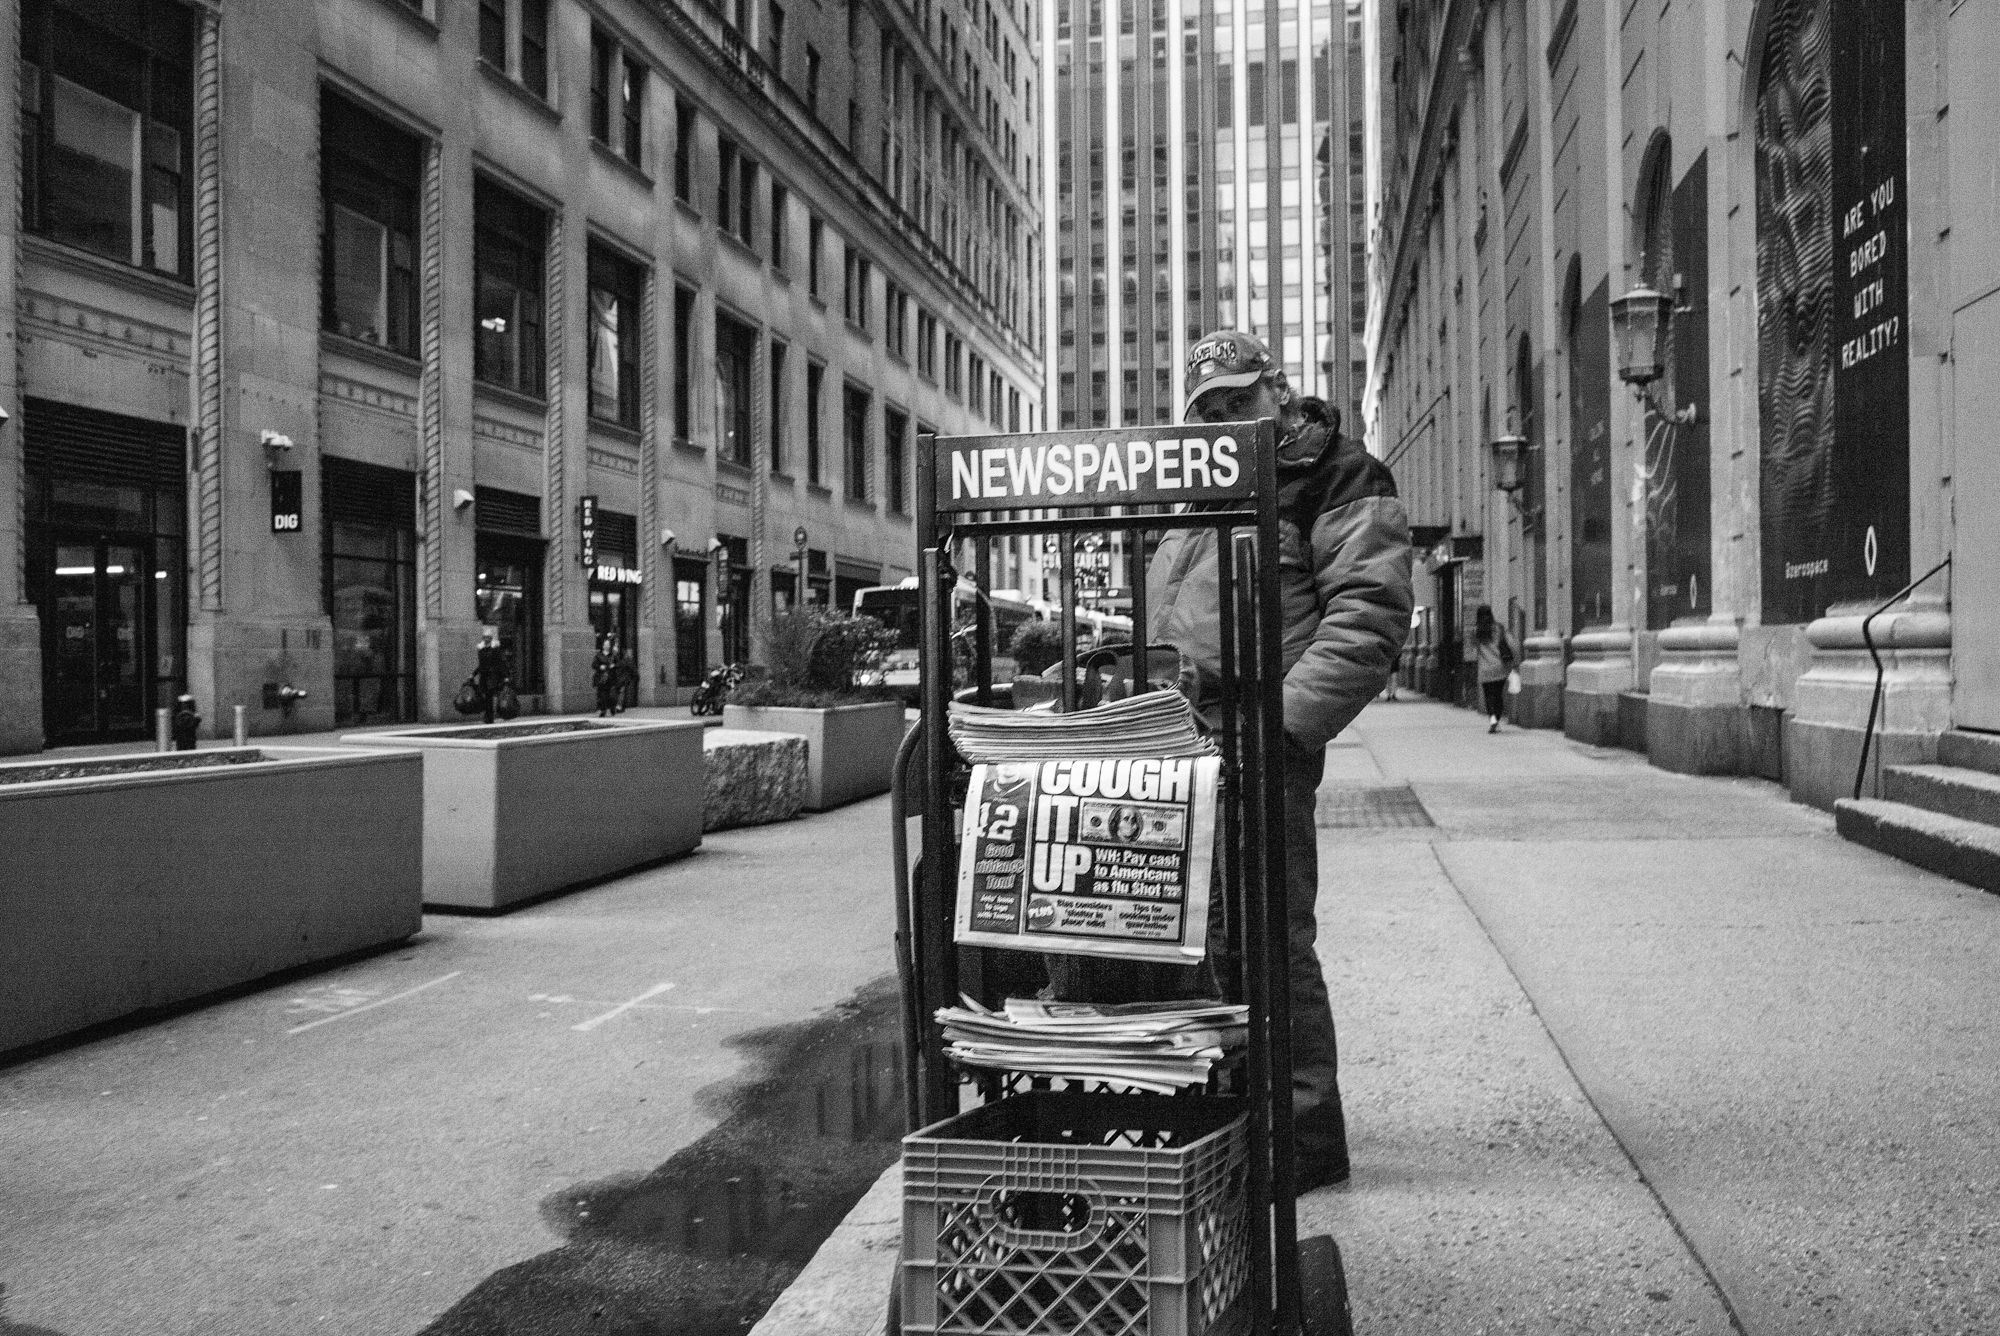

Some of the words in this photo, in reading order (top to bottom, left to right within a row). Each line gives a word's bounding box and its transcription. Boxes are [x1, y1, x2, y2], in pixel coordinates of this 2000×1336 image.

[1843, 200, 1865, 239] ARE
[1871, 176, 1894, 216] YOU
[1850, 230, 1887, 278] BORED
[1854, 278, 1884, 319] WITH
[1842, 316, 1899, 370] REALITY?
[951, 435, 1240, 500] NEWSPAPERS
[274, 514, 299, 529] DIG
[583, 499, 593, 526] RED
[582, 530, 595, 565] WING
[1040, 759, 1193, 802] COUGH
[977, 802, 1020, 841] 12
[1035, 794, 1080, 844] IT
[1032, 842, 1093, 893] UP
[1094, 864, 1108, 878] to
[1108, 865, 1179, 883] Americans
[1095, 848, 1122, 863] WH:
[1123, 850, 1147, 867] Pay
[1149, 853, 1180, 868] cash
[1093, 881, 1110, 893] as
[1110, 880, 1130, 894] flu
[1028, 905, 1054, 918] PLUS
[1133, 904, 1149, 915] Tips
[1151, 904, 1163, 913] for
